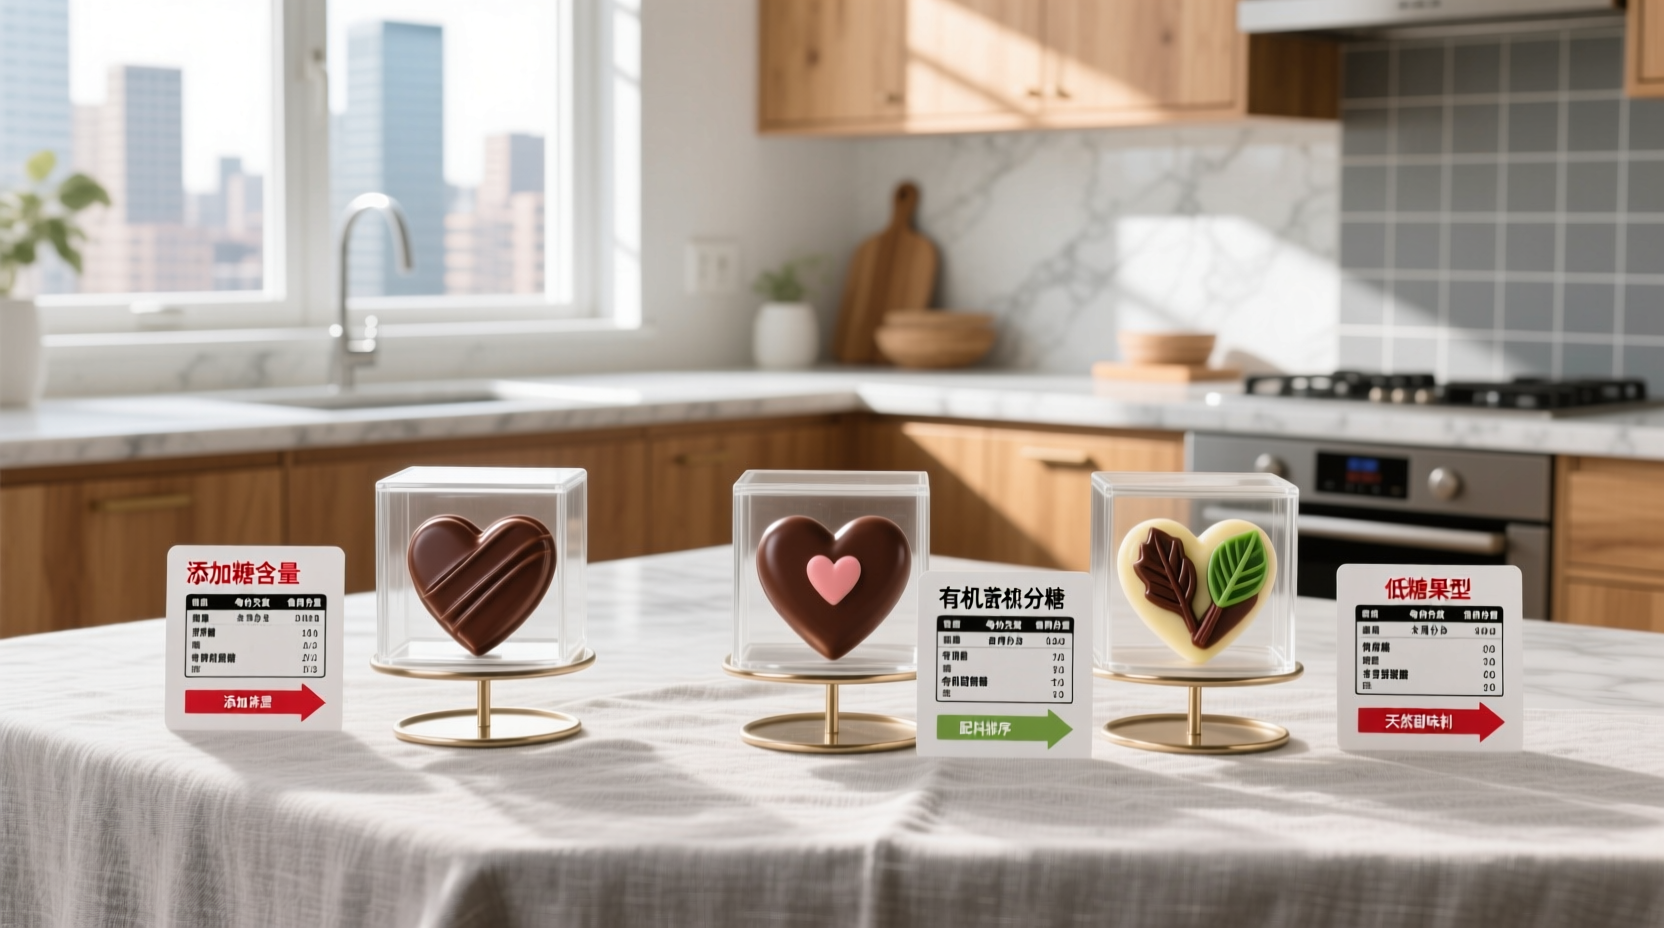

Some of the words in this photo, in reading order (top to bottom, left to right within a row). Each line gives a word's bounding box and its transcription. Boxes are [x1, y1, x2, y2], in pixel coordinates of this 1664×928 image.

[186, 560, 300, 585] 添加糖含量
[1385, 576, 1471, 600] 低糖果型
